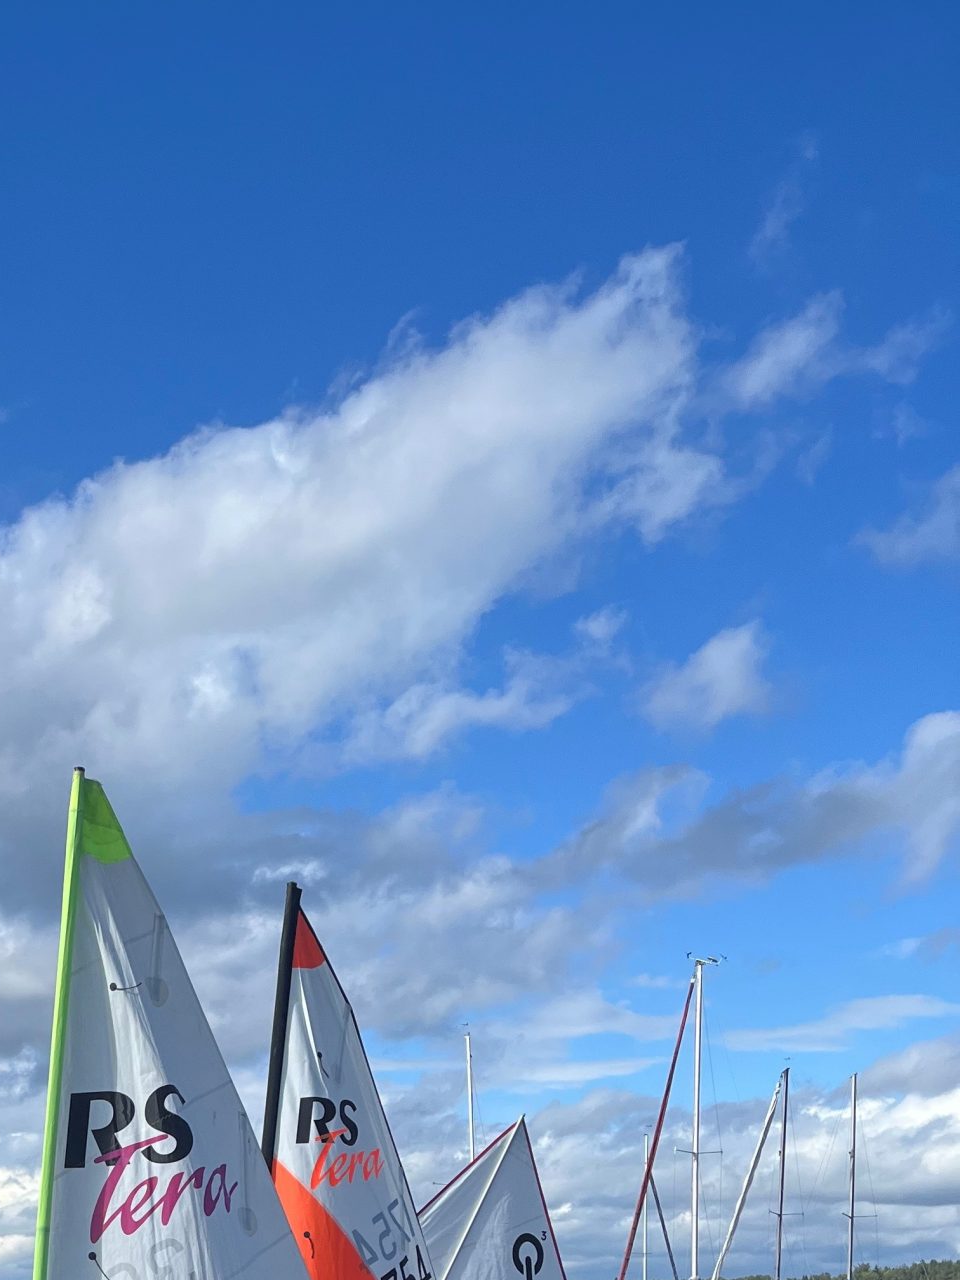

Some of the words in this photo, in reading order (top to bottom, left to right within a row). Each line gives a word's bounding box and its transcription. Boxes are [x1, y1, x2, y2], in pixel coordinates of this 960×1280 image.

[64, 1084, 193, 1168] RS
[296, 1097, 358, 1146] RS
[90, 1134, 238, 1244] Tera
[310, 1128, 384, 1190] Tera
